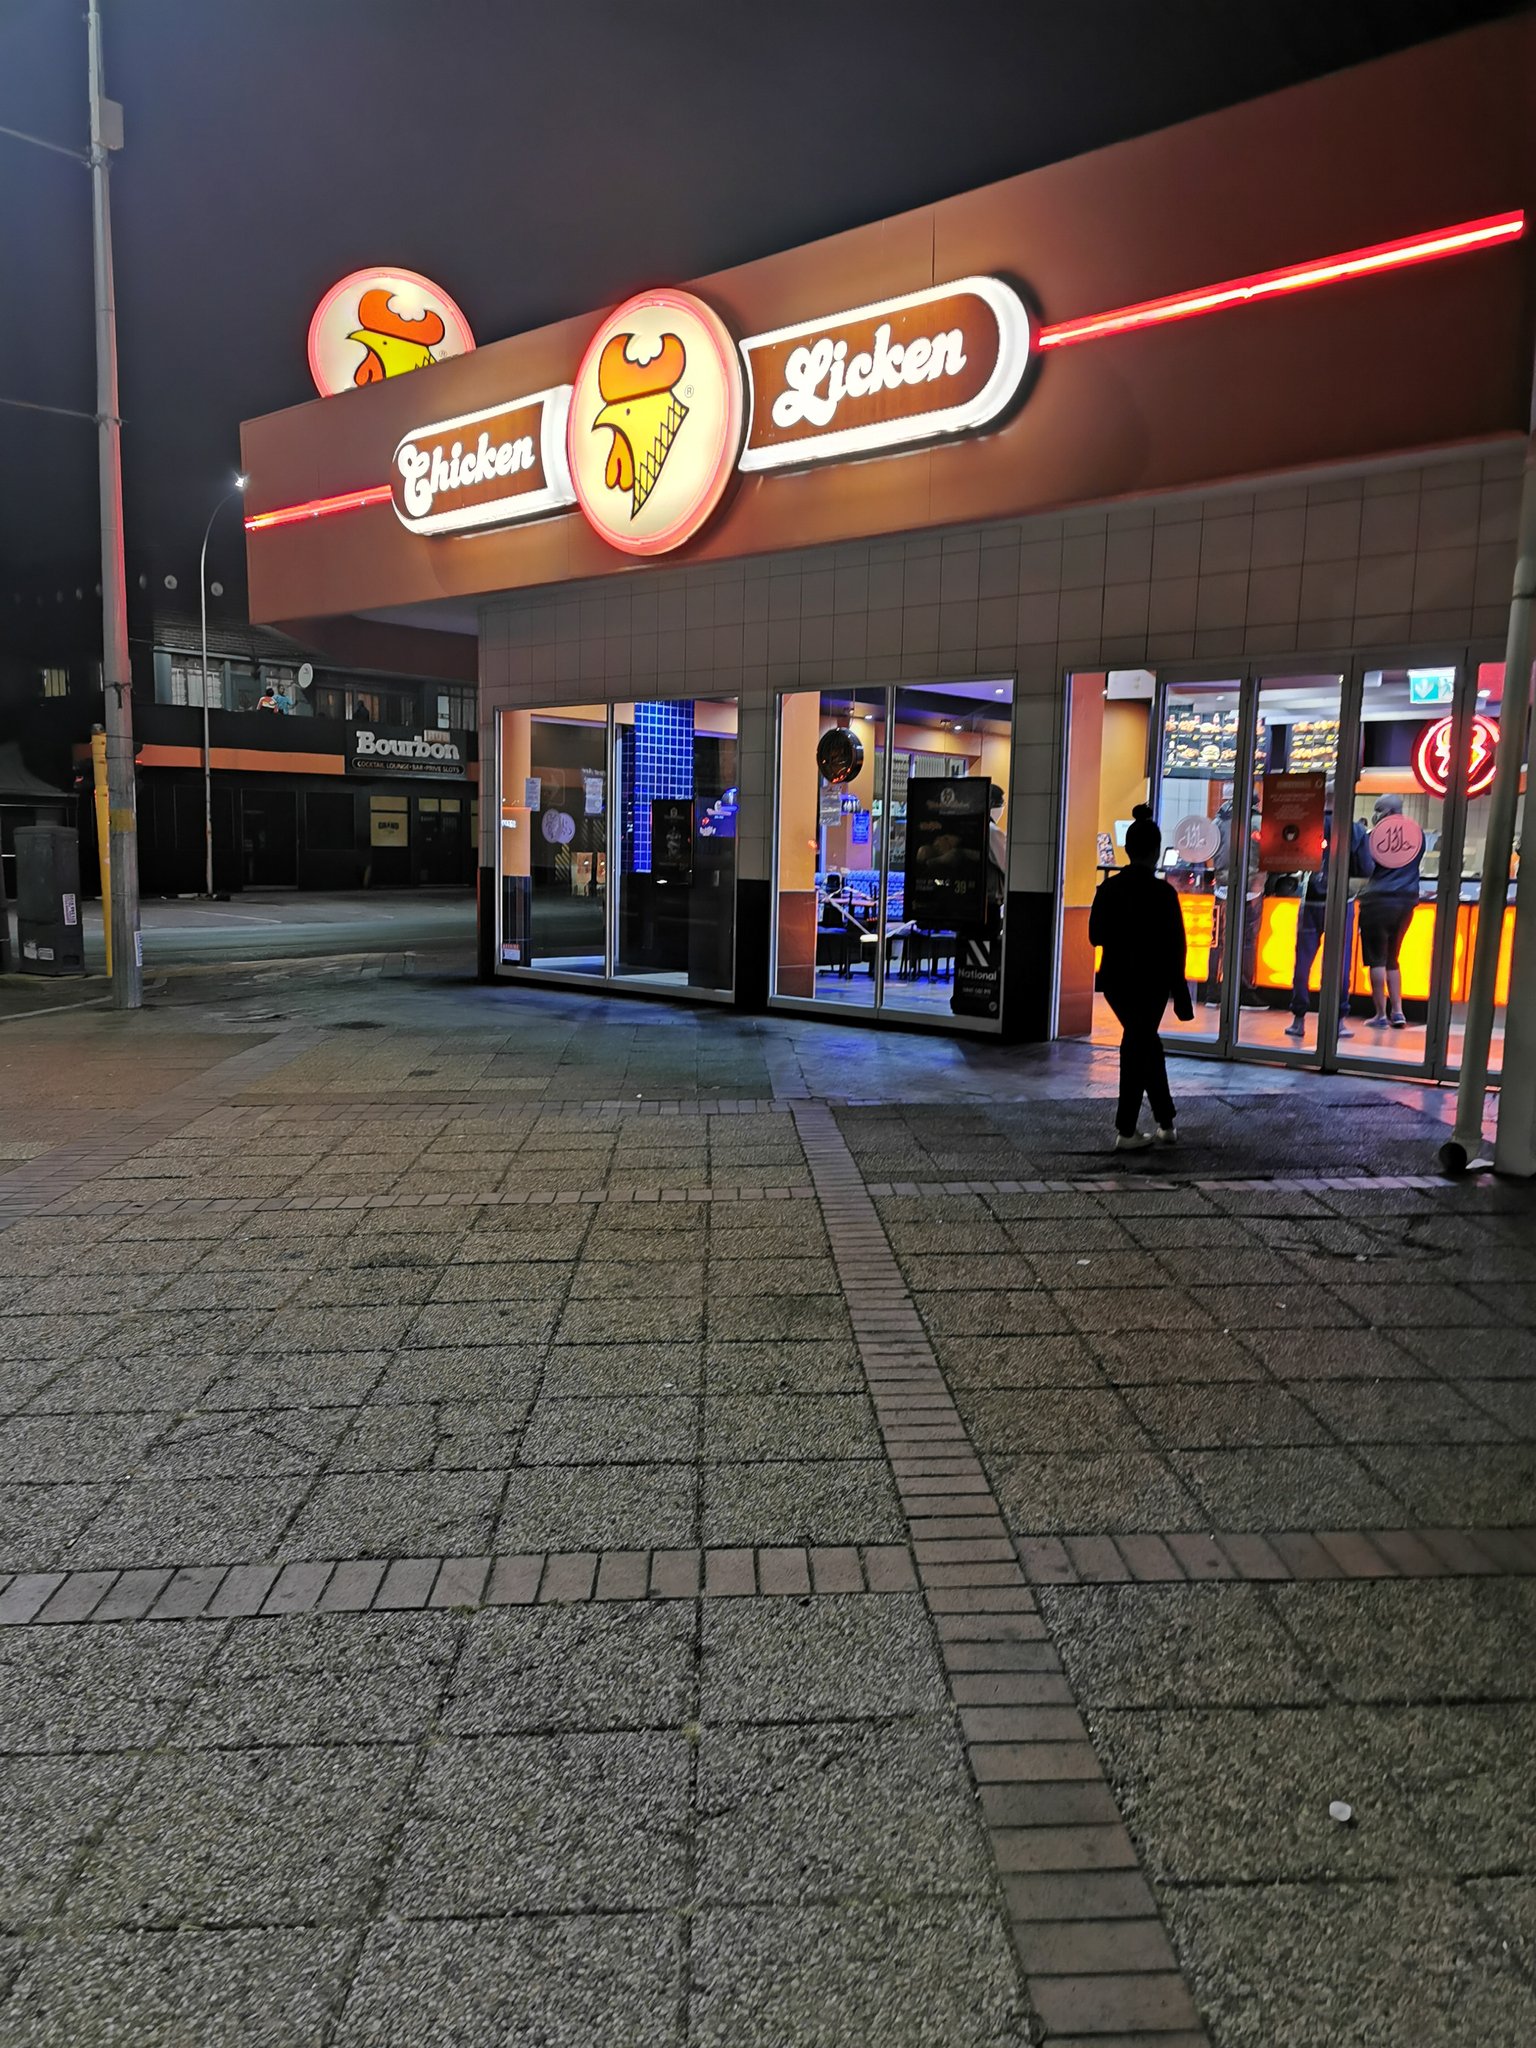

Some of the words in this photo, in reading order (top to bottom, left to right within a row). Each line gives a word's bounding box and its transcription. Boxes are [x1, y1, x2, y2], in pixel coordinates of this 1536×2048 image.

[397, 431, 536, 517] Chicken
[772, 323, 967, 428] Licken
[356, 730, 460, 760] Bourbon
[442, 765, 460, 773] SLOTS
[958, 967, 997, 982] National
